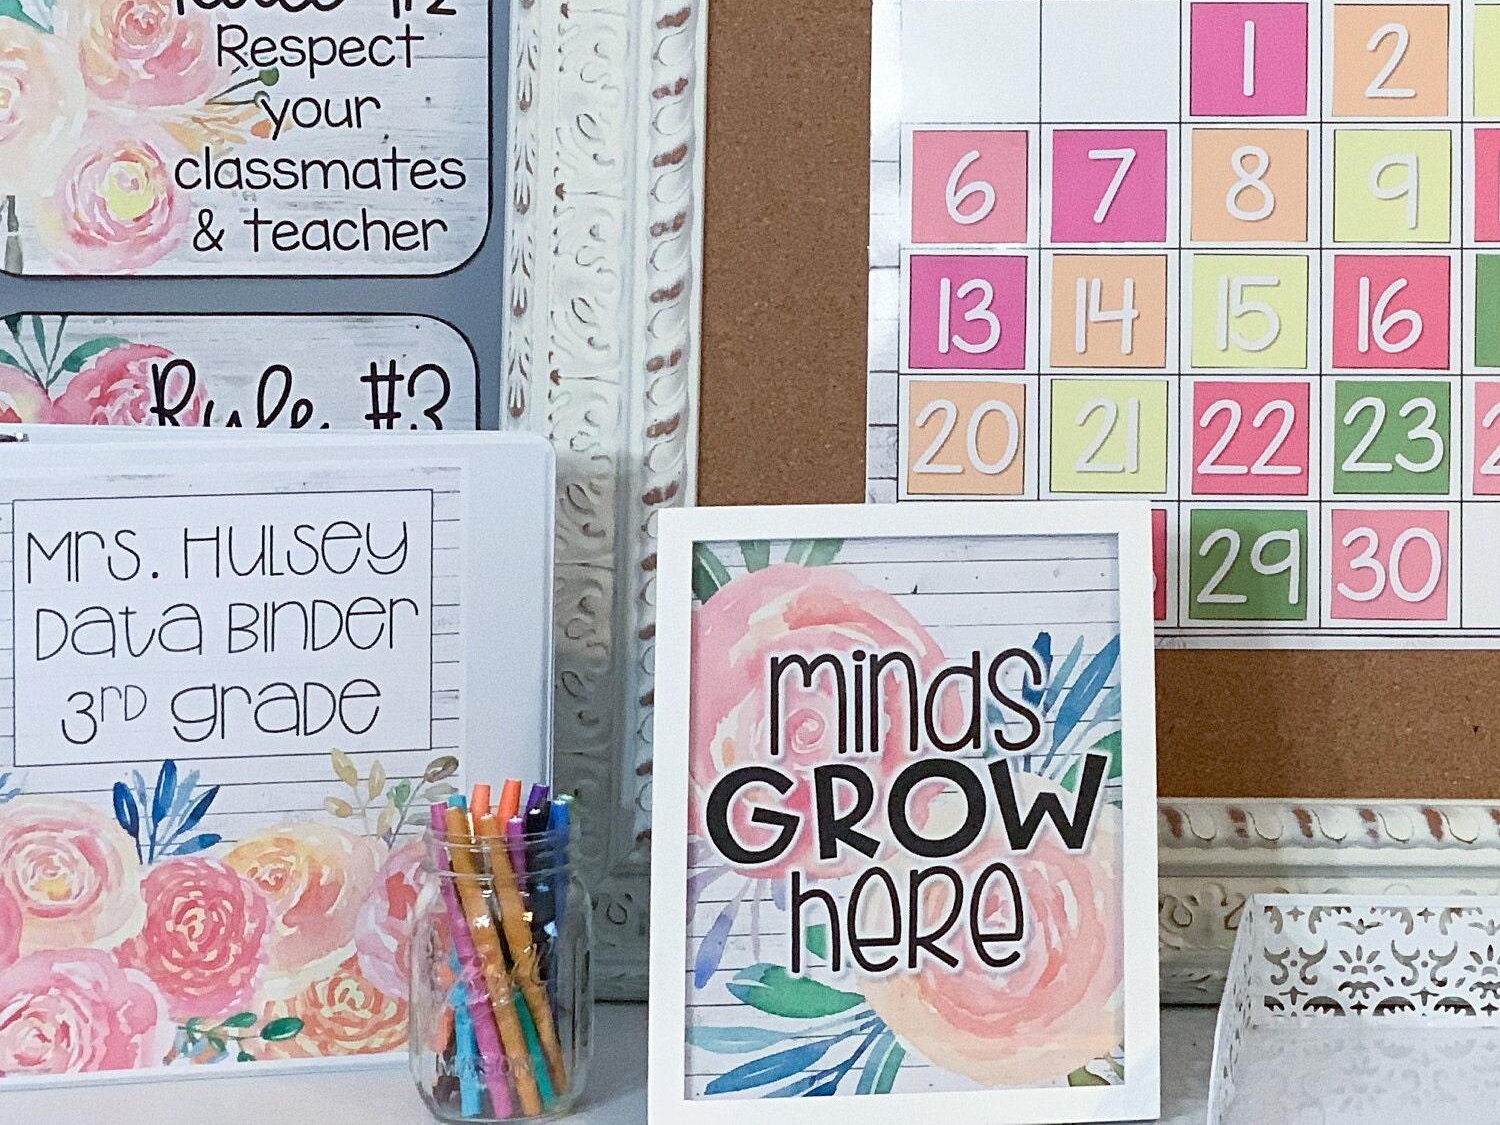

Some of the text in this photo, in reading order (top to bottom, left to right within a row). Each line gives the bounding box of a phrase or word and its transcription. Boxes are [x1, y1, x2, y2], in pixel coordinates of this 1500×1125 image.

[217, 24, 424, 79] Respect
[1244, 20, 1255, 96] 1
[1364, 23, 1416, 98] 2
[259, 94, 381, 141] your
[175, 146, 466, 190] classmates
[945, 150, 995, 225] 6
[1088, 148, 1136, 224] 7
[1225, 146, 1275, 222] 8
[1368, 152, 1419, 229] 9
[193, 208, 448, 252] & teacher
[938, 278, 1000, 354] 13
[1075, 278, 1139, 355] 14
[1217, 275, 1280, 352] 15
[1357, 276, 1423, 354] 16
[912, 399, 1019, 475] 20
[1074, 397, 1139, 474] 21
[1197, 399, 1301, 475] 22
[1341, 396, 1444, 472] 23
[1196, 527, 1442, 605] 29 30
[770, 648, 1043, 756] minds
[706, 754, 1107, 865] GROW
